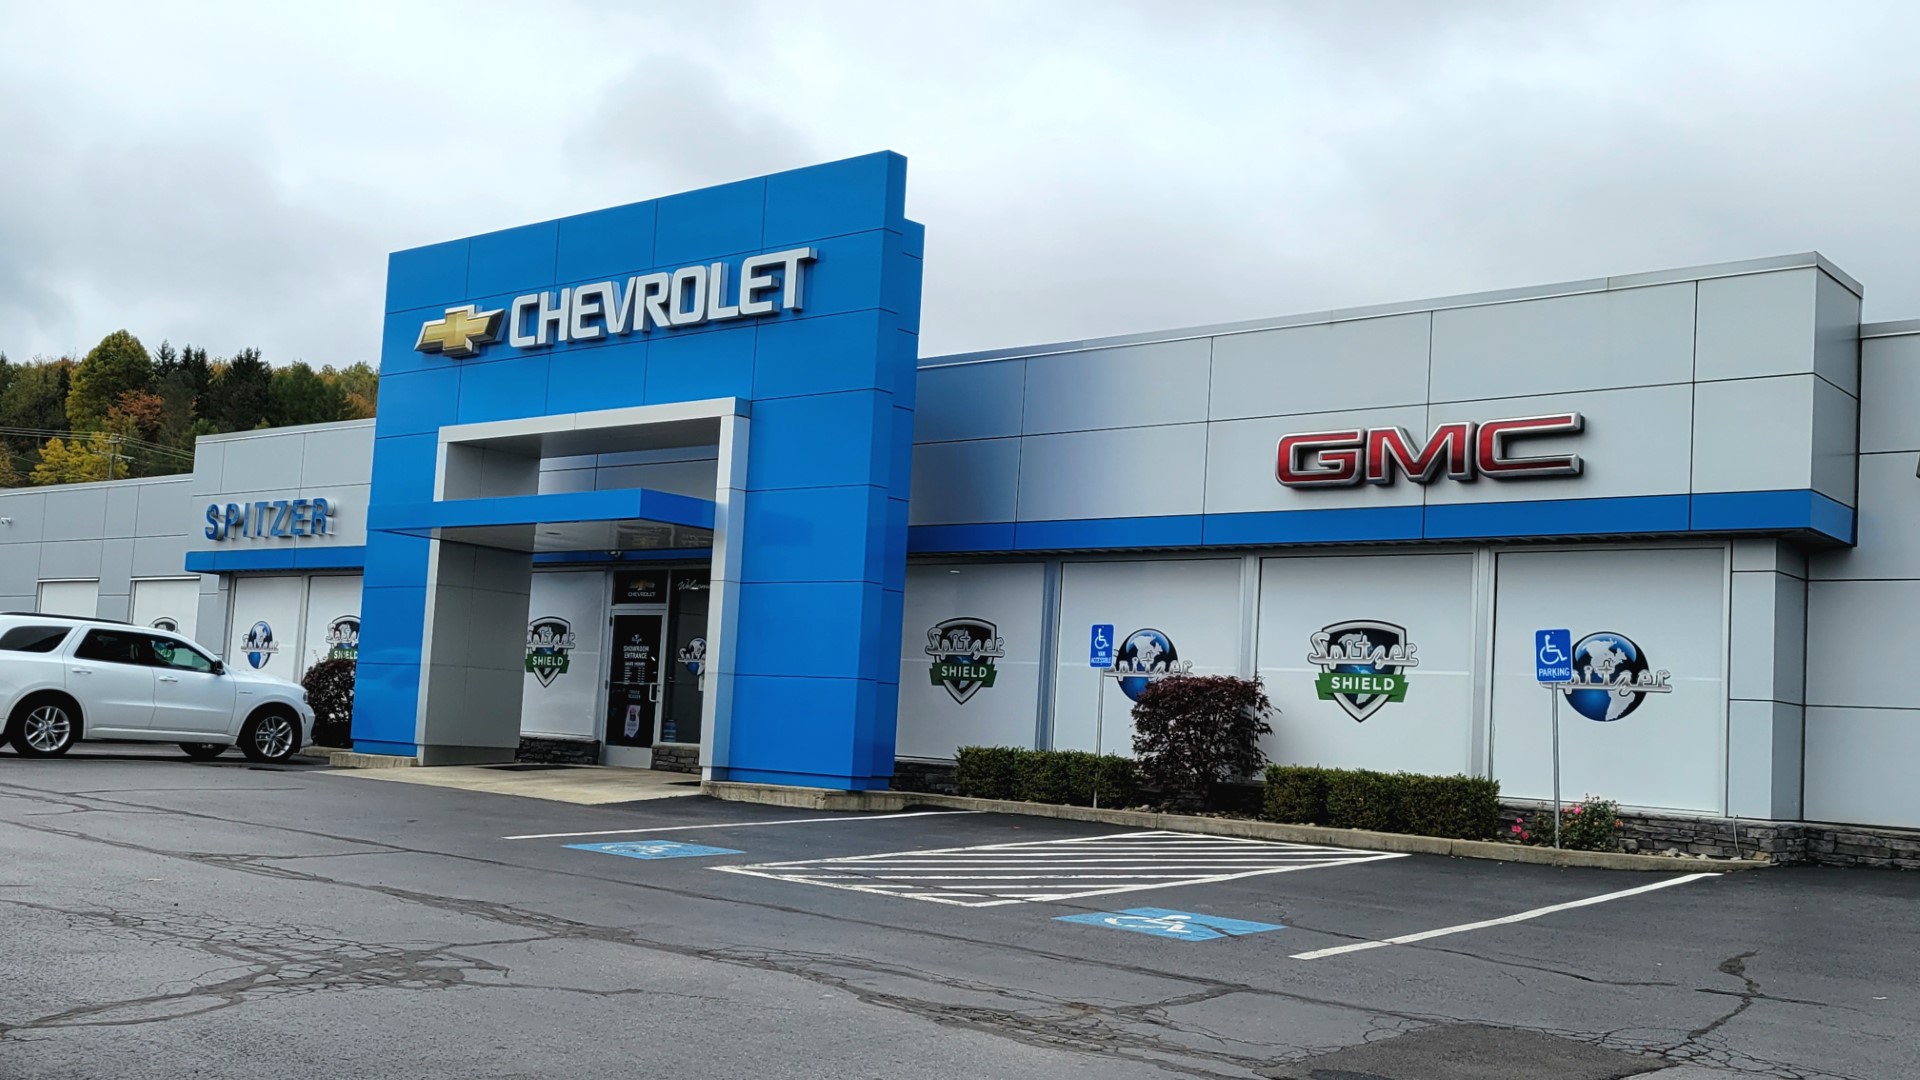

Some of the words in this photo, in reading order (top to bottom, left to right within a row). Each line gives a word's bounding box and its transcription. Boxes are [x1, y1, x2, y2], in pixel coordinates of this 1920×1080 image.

[509, 246, 817, 348] CHEVROLET
[1275, 411, 1585, 488] GMC
[205, 498, 333, 540] SPITZER
[678, 578, 711, 591] Welcom
[924, 626, 1005, 660] Spitzer
[1307, 631, 1419, 670] Spitzer
[532, 655, 564, 666] SHIELD
[941, 665, 987, 678] SHIELD
[1538, 667, 1570, 678] PARKING
[1331, 676, 1395, 691] SHIELD
[1540, 660, 1672, 697] pitzer
